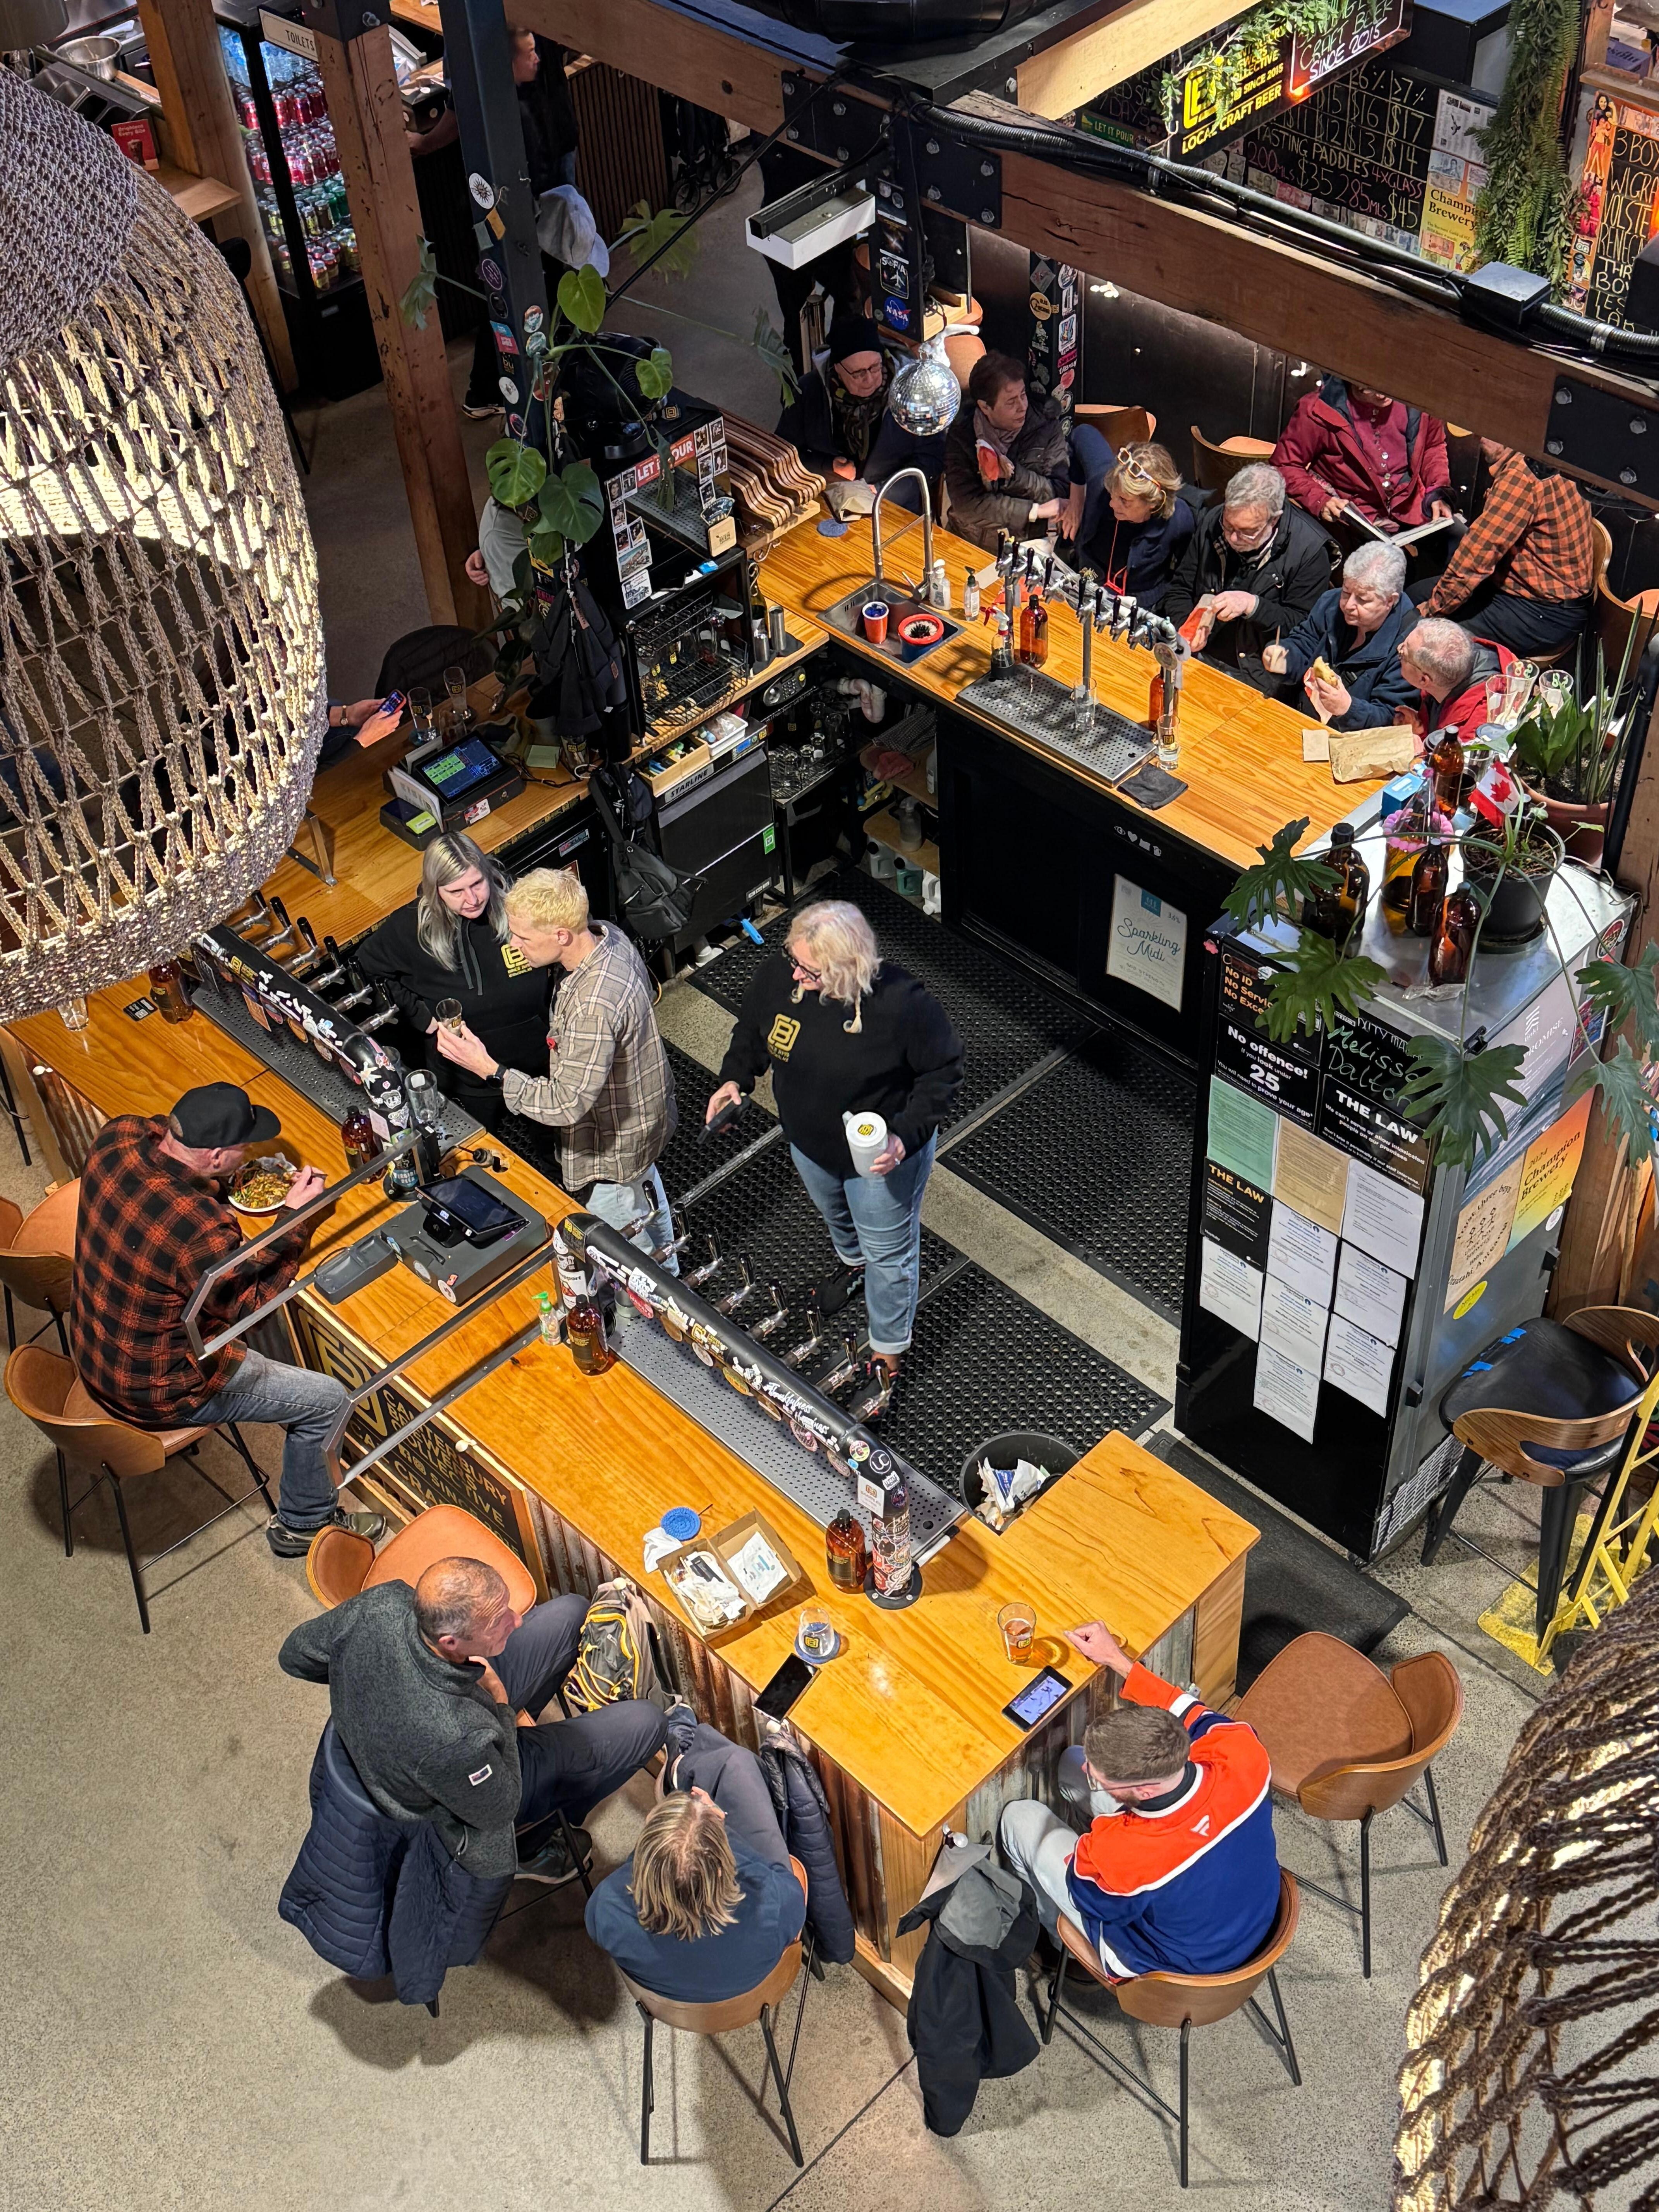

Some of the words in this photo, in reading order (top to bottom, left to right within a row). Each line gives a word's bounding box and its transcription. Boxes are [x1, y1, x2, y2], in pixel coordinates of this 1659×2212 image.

[285, 30, 314, 51] TOILETS
[1310, 43, 1345, 79] SINCE
[1350, 17, 1387, 53] 2015
[1243, 73, 1266, 93] SINCE
[1267, 63, 1283, 80] 2015
[1110, 96, 1150, 127] DAYS
[1219, 100, 1254, 131] CRAFT
[1255, 85, 1282, 110] BEER
[1351, 88, 1379, 128] $16
[1388, 104, 1424, 143] $17
[1095, 121, 1106, 132] LET
[1116, 129, 1134, 143] POUR
[1317, 114, 1341, 146] $12
[1348, 124, 1375, 158] $13
[1384, 138, 1418, 175] $14
[1614, 129, 1627, 156] 3
[1257, 124, 1309, 156] TASTING
[1313, 143, 1370, 177] PADDLES
[1296, 157, 1334, 195] $35
[1386, 189, 1420, 228] $45
[1611, 161, 1659, 203] WIGRA
[1429, 201, 1477, 231] Brewery
[1604, 190, 1652, 238] VOLSTE
[1598, 223, 1643, 267] RENEGA
[882, 256, 906, 275] SOFIA
[1599, 256, 1633, 280] THR
[886, 305, 908, 321] NASA
[637, 463, 655, 481] LET
[672, 441, 694, 461] OUR
[671, 768, 708, 798] STARLINE
[1117, 917, 1181, 956] Sparkling
[1127, 940, 1165, 962] Midi
[1225, 965, 1239, 979] No
[1242, 974, 1253, 986] ID
[1224, 976, 1238, 989] No
[1241, 986, 1273, 1009] Servic
[1224, 986, 1237, 1000] No
[1228, 1025, 1246, 1044] No
[1249, 1041, 1308, 1080] offence!
[1246, 1050, 1257, 1062] you
[1257, 1056, 1273, 1070] look
[1274, 1066, 1291, 1080] under
[1217, 1060, 1228, 1071] You
[1237, 1072, 1251, 1085] need
[1257, 1084, 1278, 1102] prove
[1278, 1096, 1296, 1112] your
[1249, 1063, 1279, 1092] 25
[1336, 1089, 1370, 1119] THE
[1375, 1113, 1418, 1144] LAW
[1524, 1131, 1580, 1187] Champion
[1209, 1164, 1234, 1185] THE
[1237, 1181, 1264, 1204] LAW
[1520, 1152, 1568, 1202] Brewery
[1477, 1190, 1498, 1211] three
[763, 1382, 813, 1414] Thankfulness
